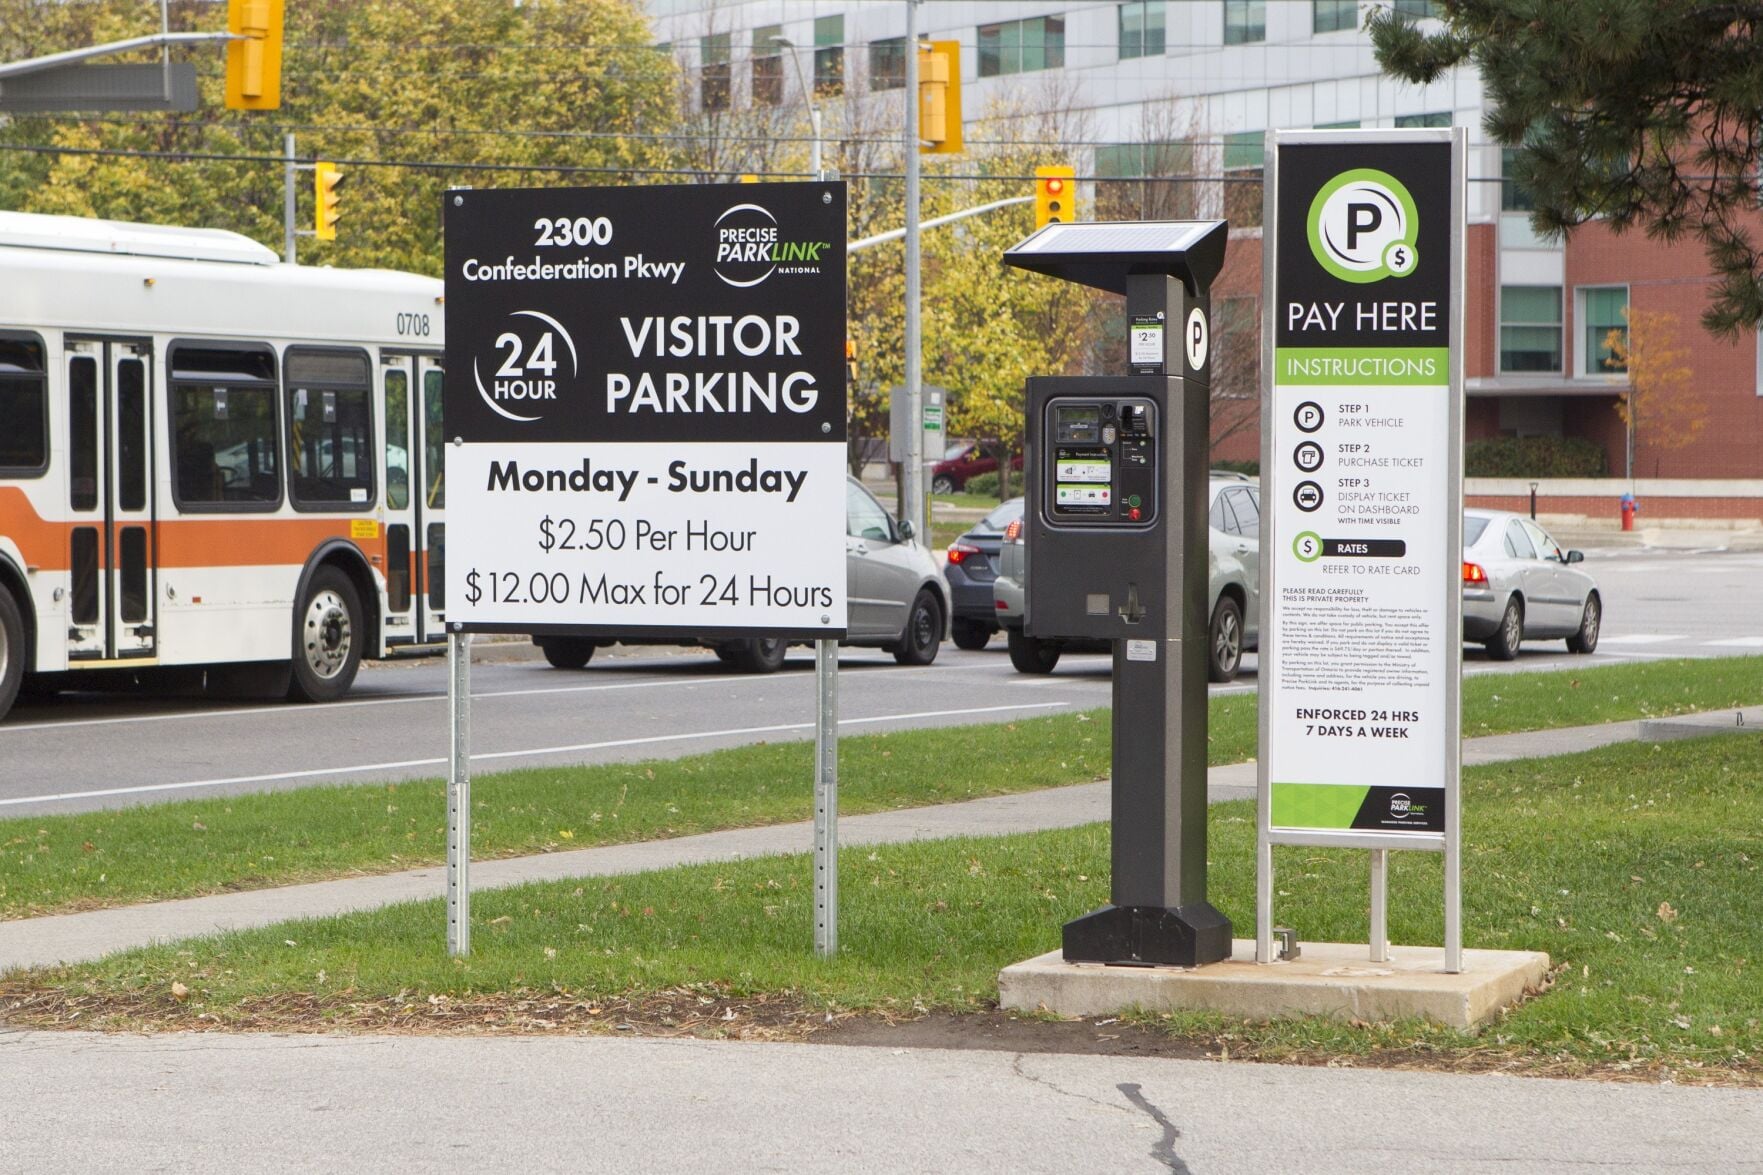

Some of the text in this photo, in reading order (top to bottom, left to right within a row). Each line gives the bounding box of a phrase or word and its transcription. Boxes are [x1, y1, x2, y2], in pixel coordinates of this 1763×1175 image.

[534, 217, 613, 246] 2300
[1347, 203, 1382, 250] P
[720, 228, 778, 244] PRECISE
[463, 254, 685, 284] Confederation Pkwy
[397, 312, 430, 337] 0708
[1289, 302, 1436, 331] PAY HERE
[620, 315, 802, 358] VISITOR
[495, 332, 557, 376] 24
[1288, 359, 1435, 376] INSTRUCTIONS
[495, 380, 556, 399] HOUR
[607, 371, 818, 413] PARKING
[1339, 404, 1368, 413] STEP 1
[1339, 418, 1403, 427] PARK VEHICLE
[1339, 444, 1370, 453] STEP 2
[1338, 457, 1423, 467] PURCHASE TICKET
[487, 458, 639, 502] Monday
[668, 458, 808, 502] Sunday
[1338, 478, 1370, 487] STEP 3
[1338, 492, 1410, 502] DISPLAY TICKET
[1338, 505, 1420, 515] ON DASHBOARD
[539, 515, 756, 554] $2.50 Per Hour
[1338, 544, 1368, 553] RATES
[1323, 565, 1420, 575] REFER TO RATE CARD
[465, 568, 832, 608] $12.00 Max for 24 Hours
[1297, 708, 1419, 722] ENFORCED 24 HRS
[1306, 725, 1408, 738] 7 DAYS A WEEK
